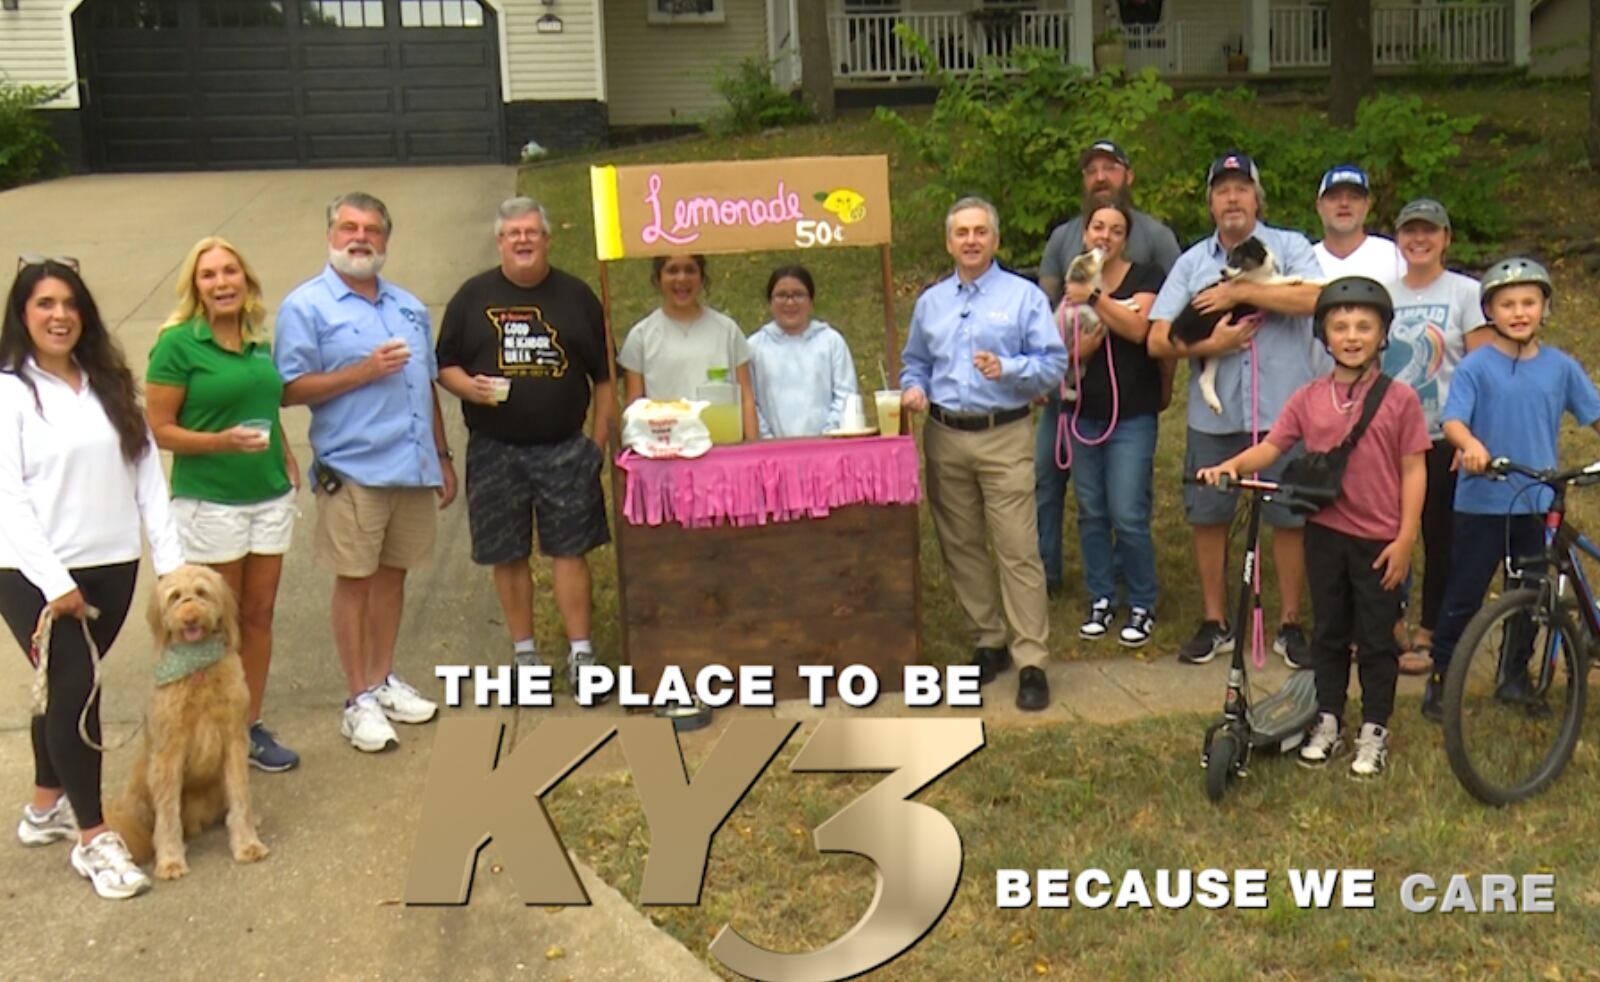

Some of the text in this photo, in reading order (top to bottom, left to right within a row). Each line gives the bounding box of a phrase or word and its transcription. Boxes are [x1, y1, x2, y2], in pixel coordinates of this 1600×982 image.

[641, 174, 804, 245] Lemonade
[795, 220, 844, 248] 50¢
[504, 322, 530, 336] GOOD
[504, 335, 551, 350] NEIGHBOR
